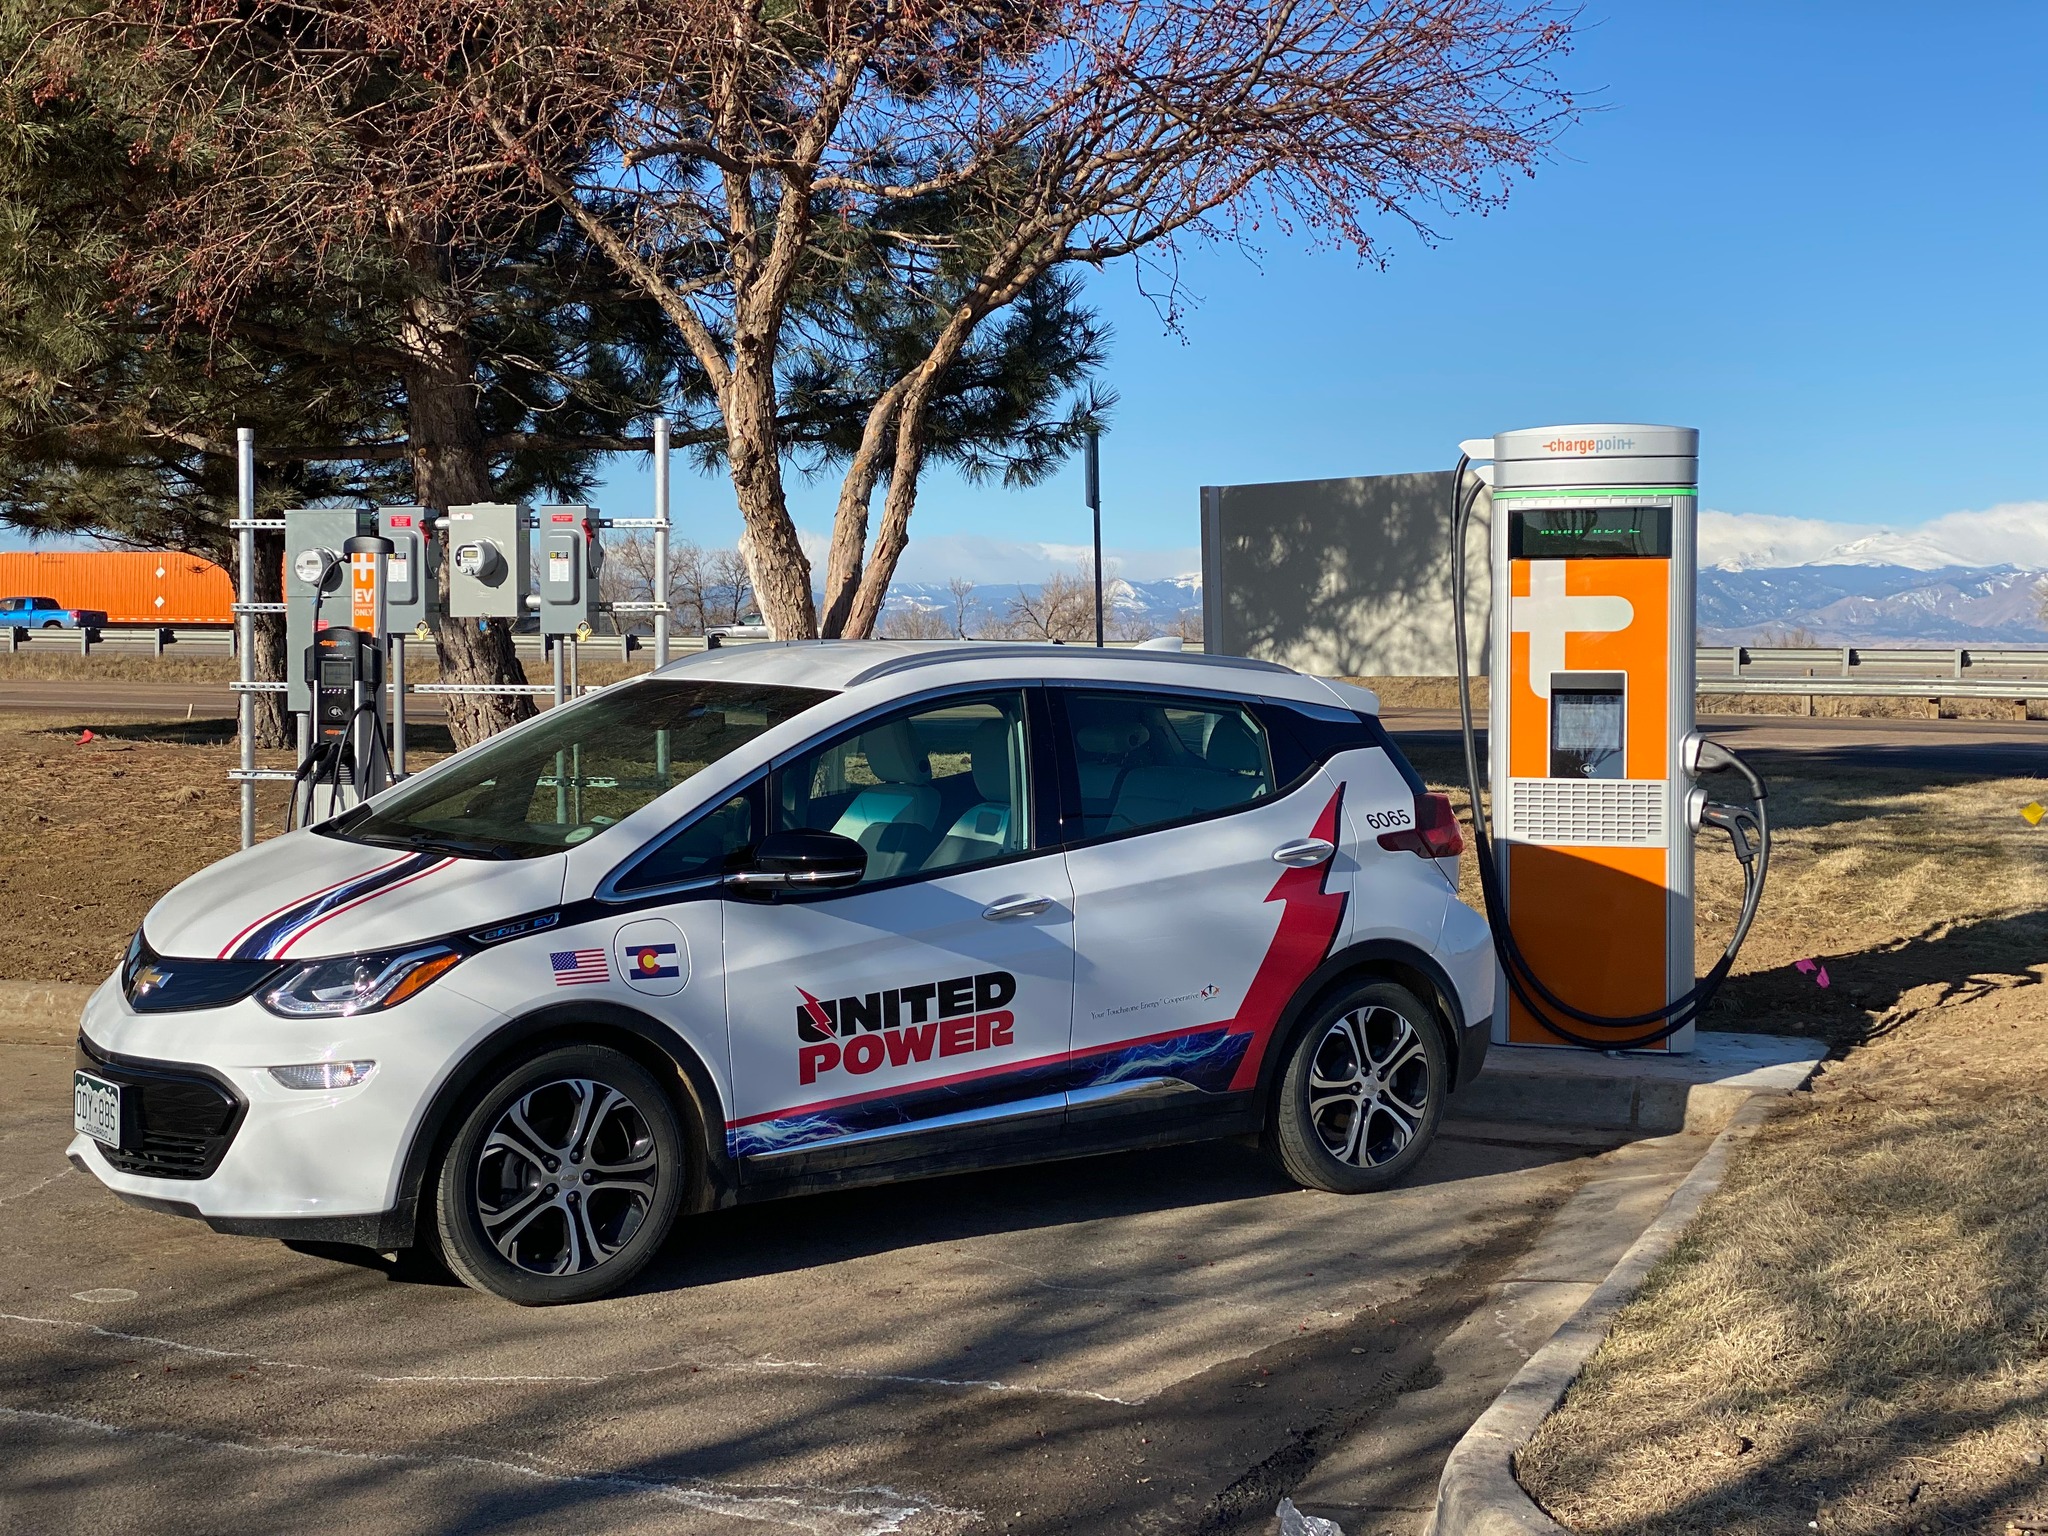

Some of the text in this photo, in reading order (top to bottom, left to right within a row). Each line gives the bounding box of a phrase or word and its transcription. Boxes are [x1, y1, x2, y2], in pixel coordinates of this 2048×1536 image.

[354, 588, 374, 602] EV
[354, 608, 374, 617] ONLY
[1366, 809, 1411, 829] 6065
[485, 915, 554, 939] BOLT EV
[795, 970, 1017, 1043] UNITED
[799, 1010, 1015, 1086] POWER
[85, 1123, 109, 1139] COLORADO
